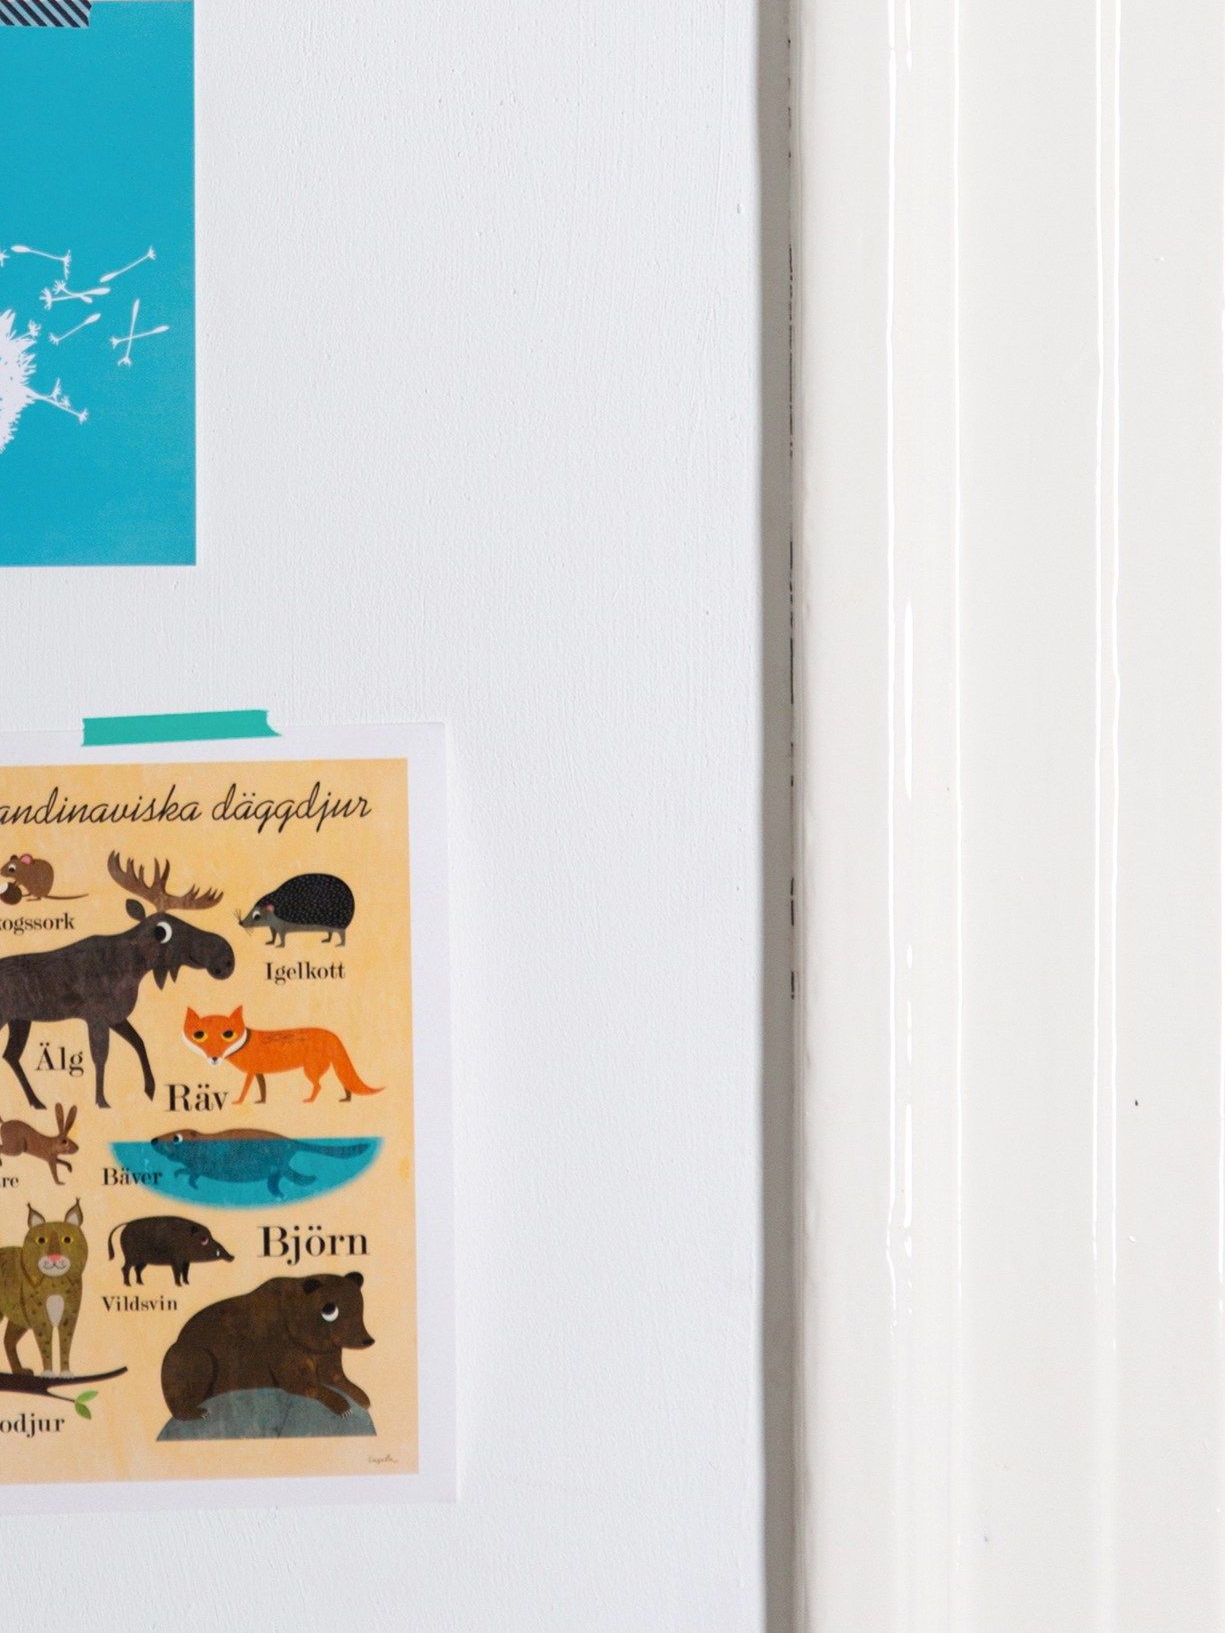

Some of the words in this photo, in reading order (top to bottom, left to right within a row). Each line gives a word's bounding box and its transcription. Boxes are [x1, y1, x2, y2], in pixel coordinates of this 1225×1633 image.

[211, 780, 372, 834] däggdjur
[266, 961, 344, 985] Igelkott
[34, 1043, 84, 1076] Älg
[165, 1083, 229, 1112] Räv
[102, 1168, 163, 1186] Bäver
[257, 1224, 371, 1266] Björn
[102, 1295, 178, 1312] Vildsvin
